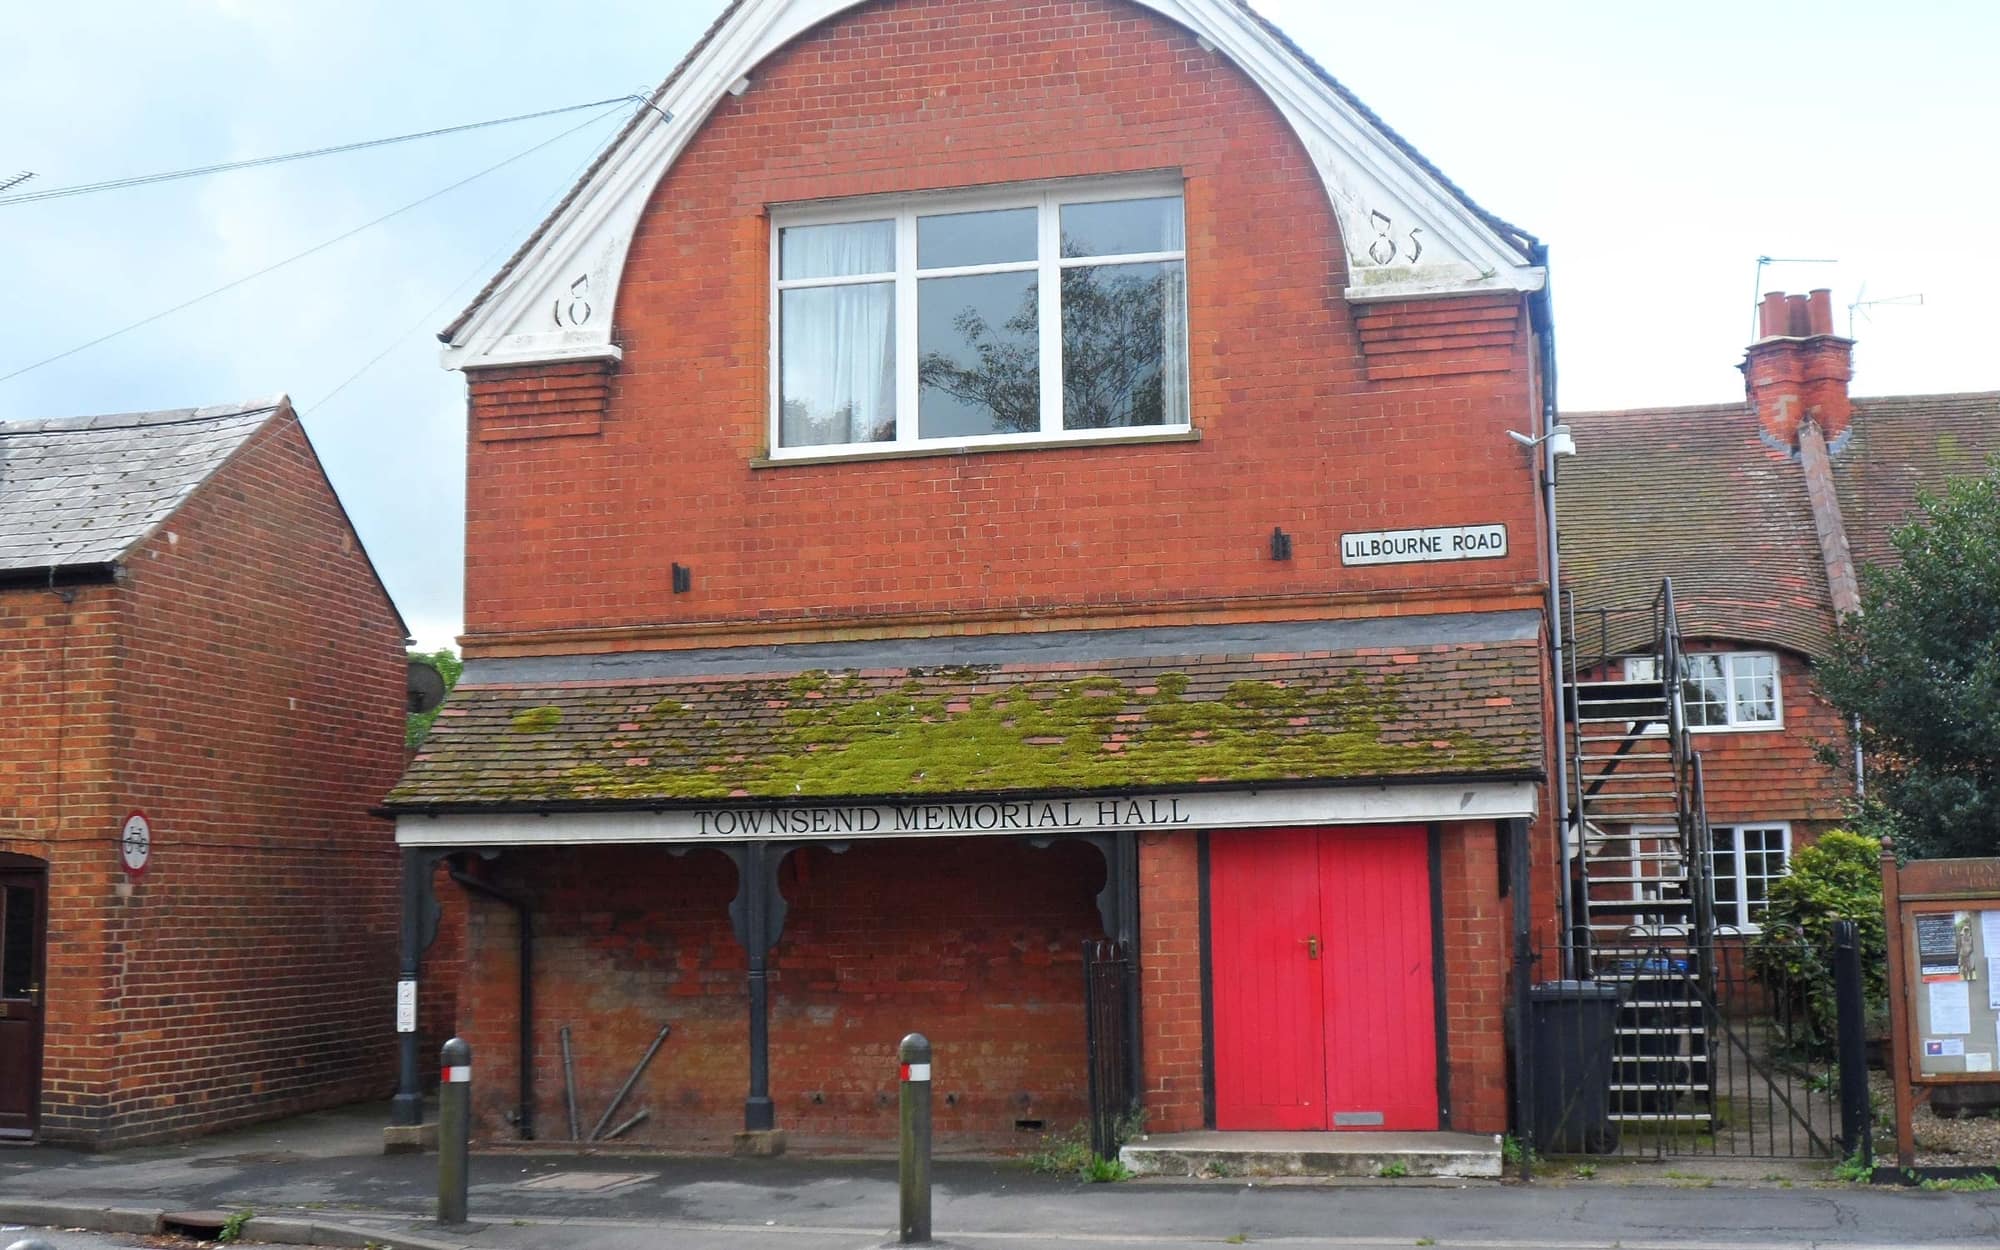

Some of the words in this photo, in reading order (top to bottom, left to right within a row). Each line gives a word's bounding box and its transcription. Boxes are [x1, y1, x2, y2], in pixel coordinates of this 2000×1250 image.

[1345, 536, 1442, 558] LILBOURNE
[1452, 532, 1503, 552] ROAD
[694, 808, 881, 835] TOWNSEND
[893, 802, 1082, 831] MEMORIAL
[1095, 799, 1190, 826] HALL
